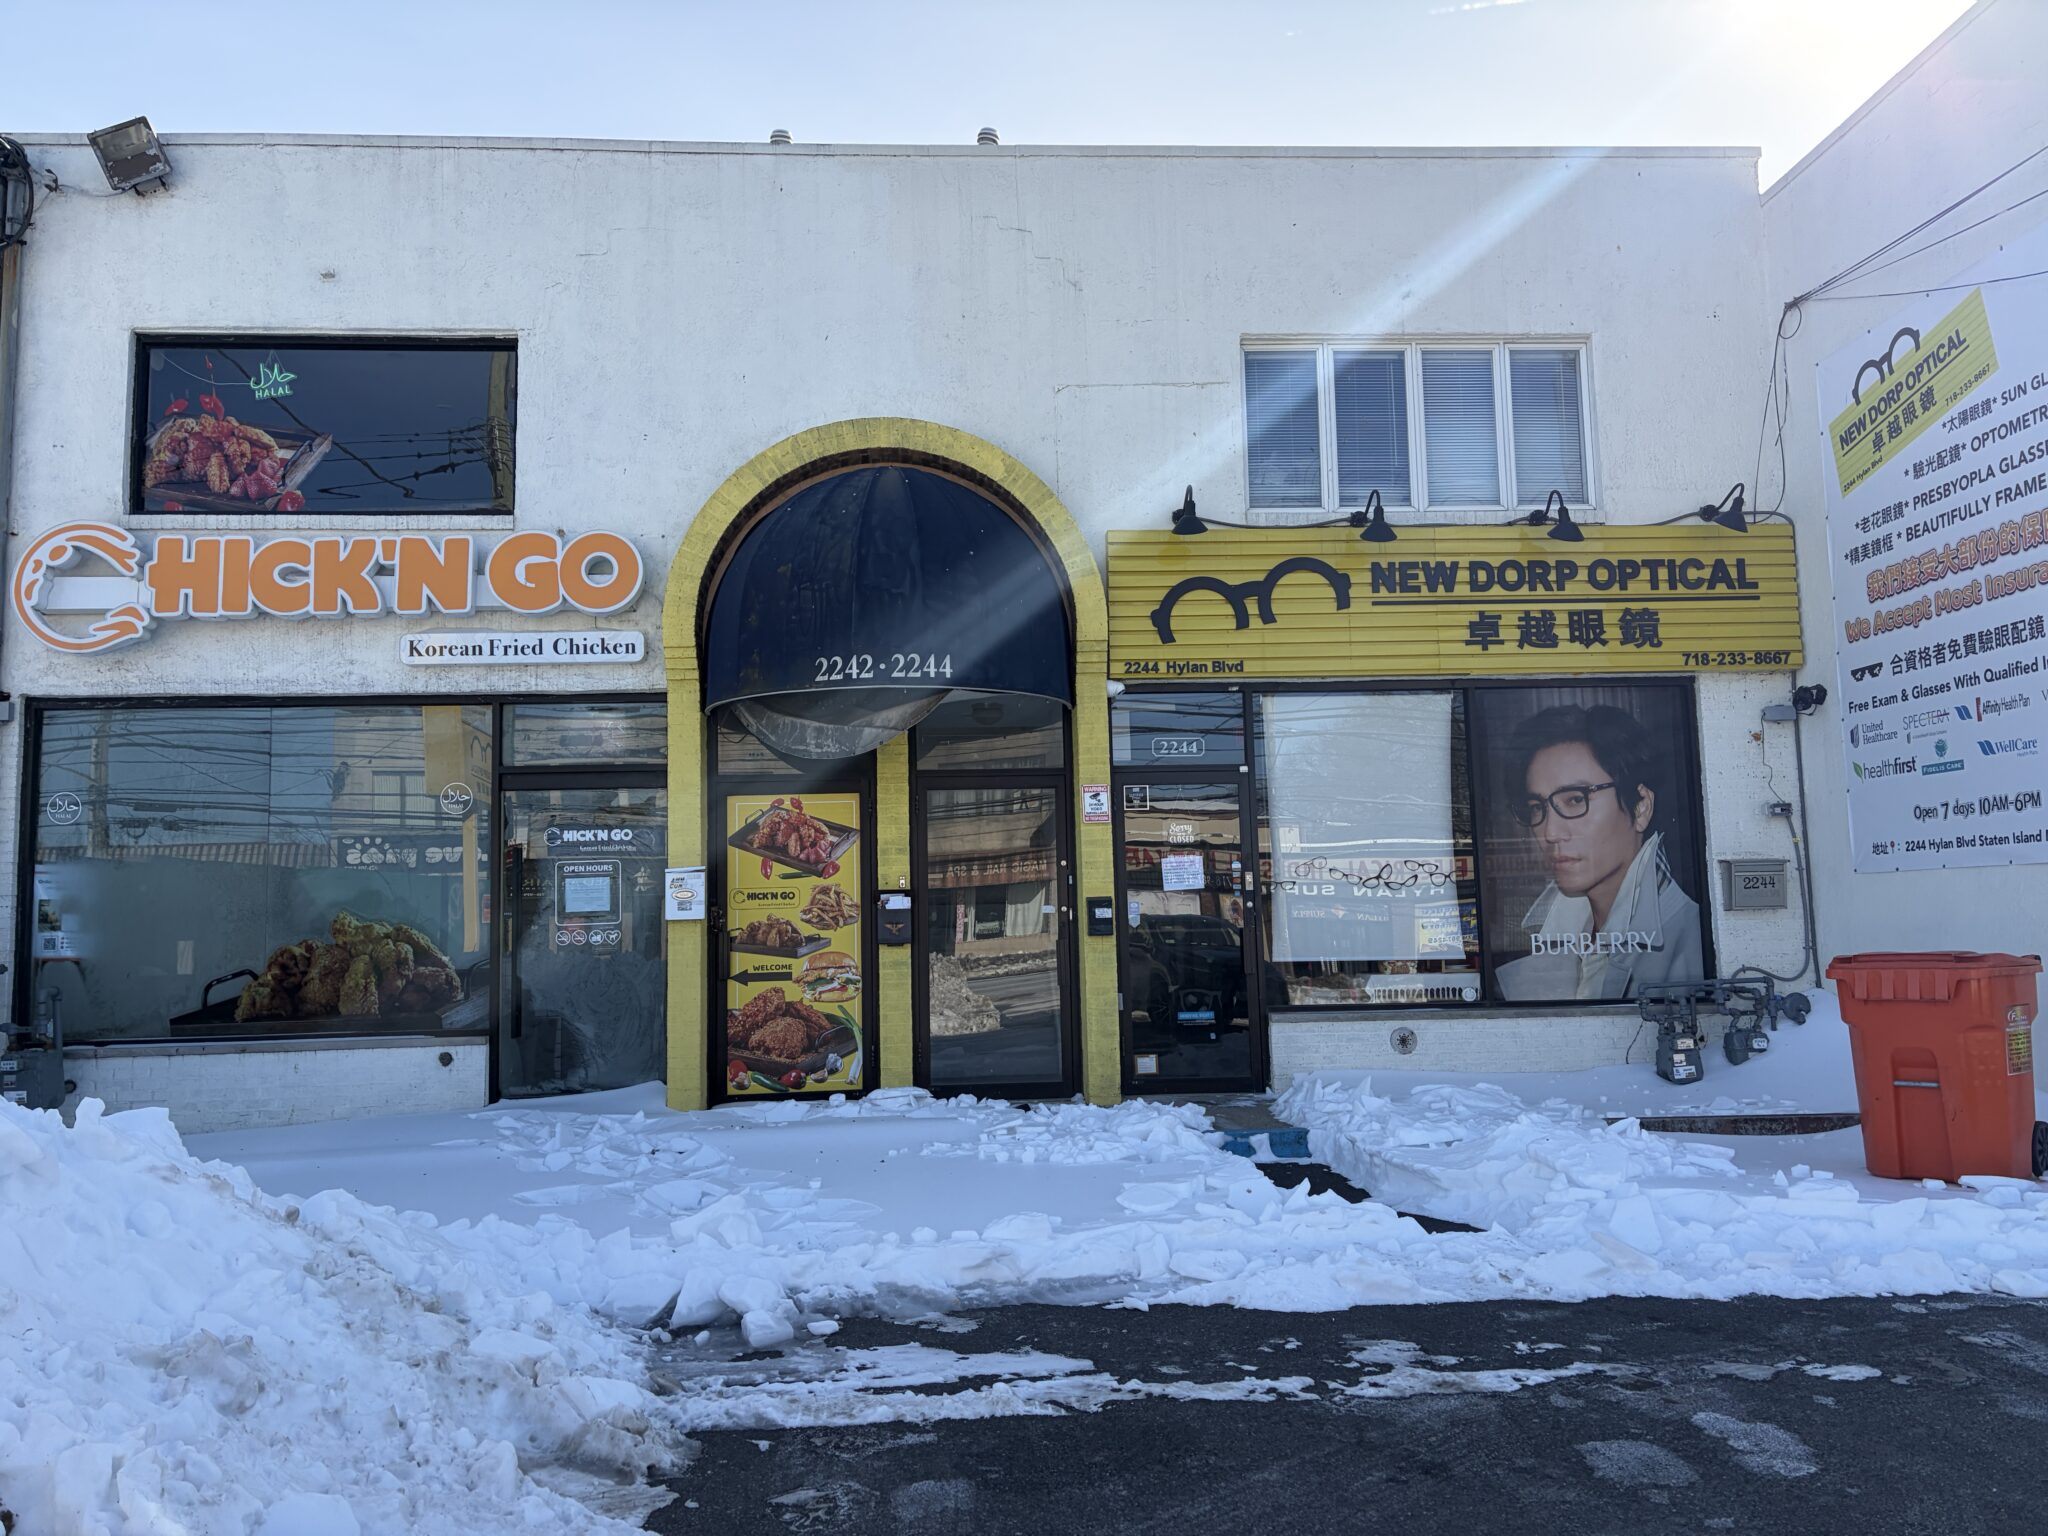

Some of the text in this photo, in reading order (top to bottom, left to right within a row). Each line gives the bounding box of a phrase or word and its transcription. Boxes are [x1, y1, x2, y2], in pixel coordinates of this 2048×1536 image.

[250, 363, 297, 388] حلال
[1944, 364, 1991, 407] 718-233-8667
[255, 385, 292, 399] HALAL
[1838, 328, 1968, 451] NEW DORP OPTICAL
[2001, 381, 2027, 406] SUN
[1872, 385, 1937, 455] 卓越眼鏡
[1970, 402, 2048, 452] OPTOMETR
[1871, 456, 1883, 470] Blvd
[1913, 464, 1996, 511] PRESBYOPLA
[1906, 495, 1991, 542] BEAUTIFULLY
[485, 529, 643, 616] GO
[1371, 558, 1758, 594] NEW DORP OPTICAL
[1845, 617, 1871, 643] We
[1873, 596, 1932, 635] Accept
[1934, 580, 1983, 616] Most
[1464, 608, 1663, 652] 卓越眼鏡
[408, 637, 636, 657] Korean Fried Chicken
[1682, 650, 1791, 666] 718-233-8667
[814, 653, 953, 682] 2242 2244
[1124, 660, 1244, 677] 2244 Hylan Blvd
[1848, 701, 1874, 714] Free
[1873, 694, 1899, 708] Exam
[1901, 689, 1909, 702] &
[1912, 682, 1951, 700] Glasses
[1953, 671, 1981, 690] With
[1984, 656, 2039, 684] Qualified
[1862, 720, 1884, 734] United
[1903, 709, 1950, 730] SPECTERA
[1160, 741, 1198, 753] 2244
[1862, 730, 1898, 745] Healthcare
[1995, 738, 2038, 753] WellCare
[1863, 757, 1917, 779] healthfirst
[1914, 805, 1938, 822] Open
[1941, 802, 1949, 820] 7
[1953, 799, 1976, 819] days
[611, 829, 633, 841] GO
[1169, 822, 1193, 835] Sorry
[1905, 841, 1926, 852] 2244
[1928, 838, 1954, 854] Hylan
[1956, 835, 1976, 848] Blvd
[1979, 832, 2010, 847] Staten
[2013, 829, 2042, 844] Island
[563, 864, 613, 873] OPEN HOURS
[1743, 876, 1776, 890] 2244
[780, 891, 795, 900] GO
[1530, 931, 1657, 956] BURBERRY
[753, 964, 793, 972] WELCOME
